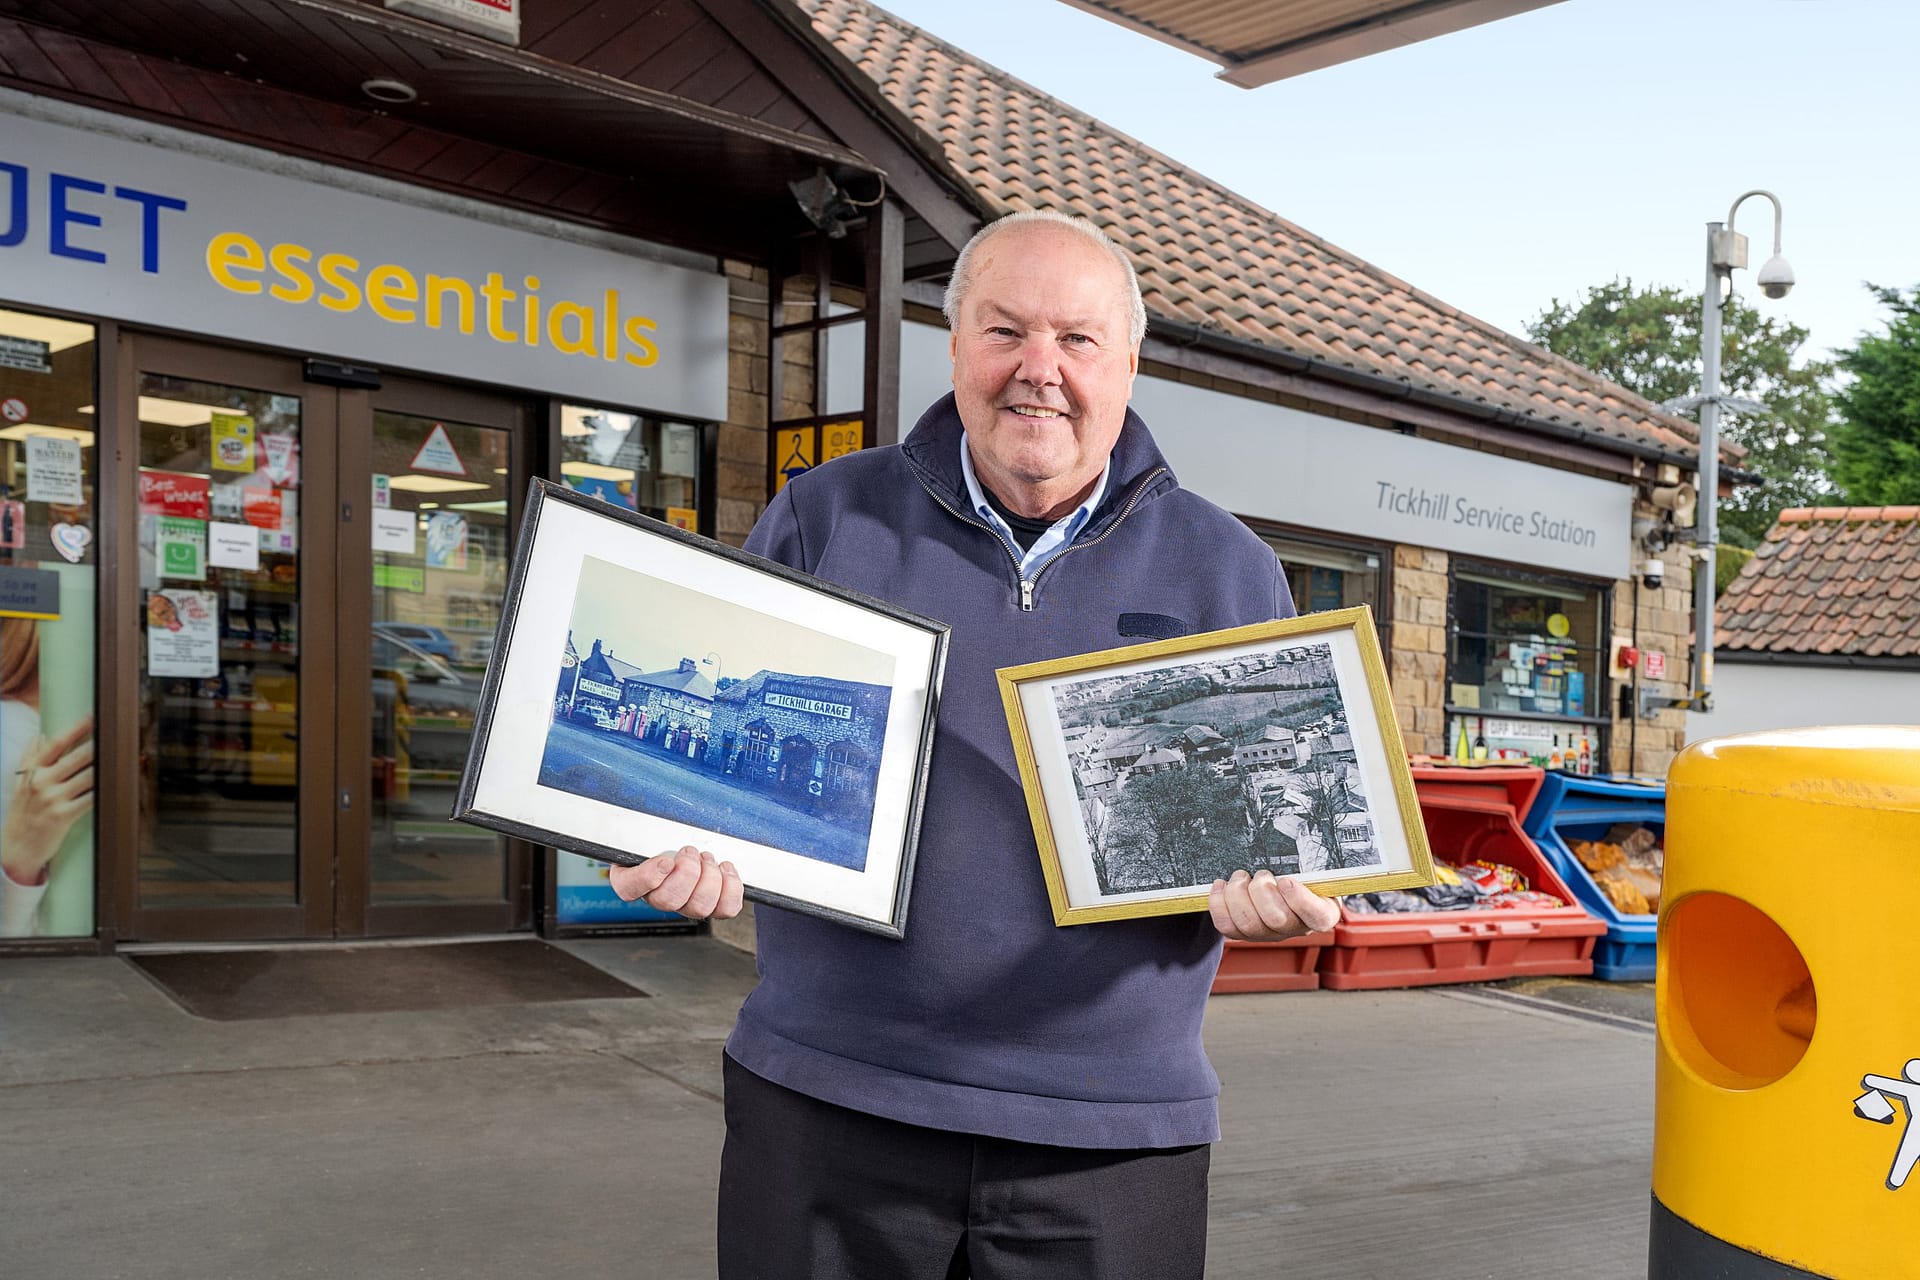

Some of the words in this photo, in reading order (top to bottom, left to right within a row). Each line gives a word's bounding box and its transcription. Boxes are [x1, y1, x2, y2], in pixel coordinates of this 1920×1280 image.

[0, 163, 187, 274] JET
[207, 232, 659, 368] essentials
[1377, 480, 1449, 521] Tickhill
[1453, 497, 1524, 535] Service
[1529, 511, 1596, 548] Station
[778, 695, 813, 711] TICKHILL
[814, 702, 850, 717] GARAGE
